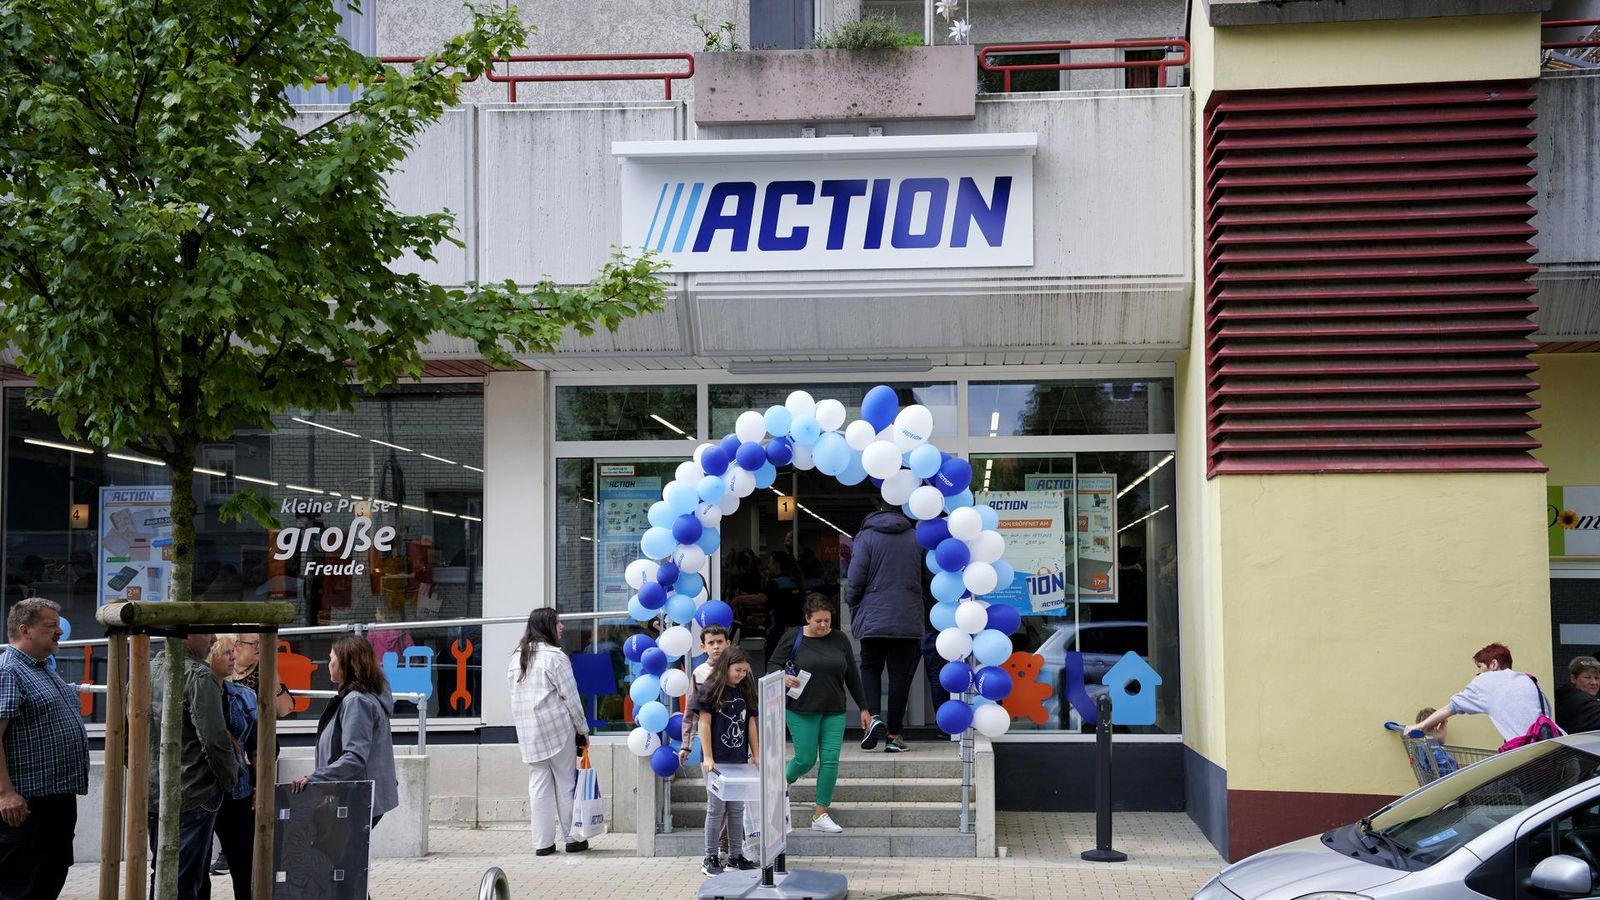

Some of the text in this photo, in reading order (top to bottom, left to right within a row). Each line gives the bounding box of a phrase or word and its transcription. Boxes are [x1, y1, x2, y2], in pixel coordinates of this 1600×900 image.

[692, 176, 1013, 253] ACTION
[608, 480, 636, 488] ACTION
[112, 491, 155, 501] ACTION
[280, 497, 390, 513] kleine Preise
[782, 501, 788, 512] 1
[988, 500, 1028, 510] ACTION
[72, 509, 80, 520] 4
[273, 516, 396, 561] große
[304, 560, 365, 576] Freude
[1042, 599, 1065, 608] ACTION
